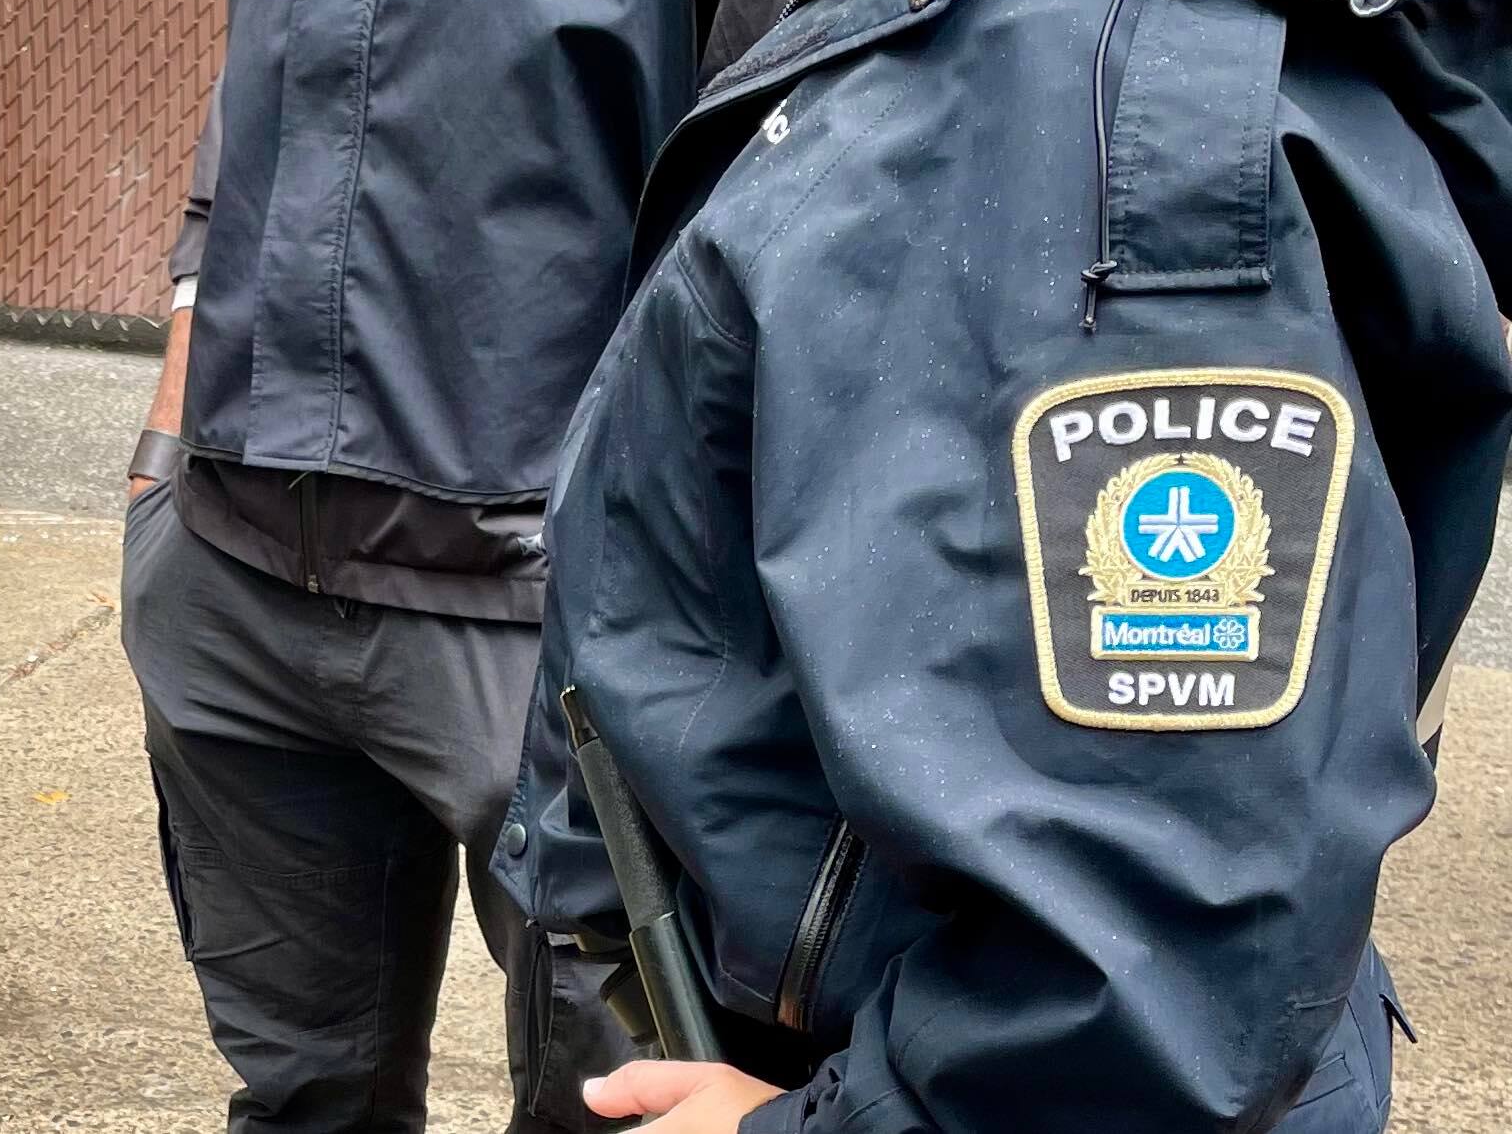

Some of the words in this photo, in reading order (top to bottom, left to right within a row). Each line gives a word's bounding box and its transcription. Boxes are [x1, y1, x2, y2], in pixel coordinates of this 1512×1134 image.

[1048, 396, 1322, 463] POLICE
[1130, 588, 1182, 603] DEPUIS
[1184, 588, 1220, 604] 1843
[1104, 619, 1211, 646] Montréal
[1107, 672, 1236, 707] SPVM
